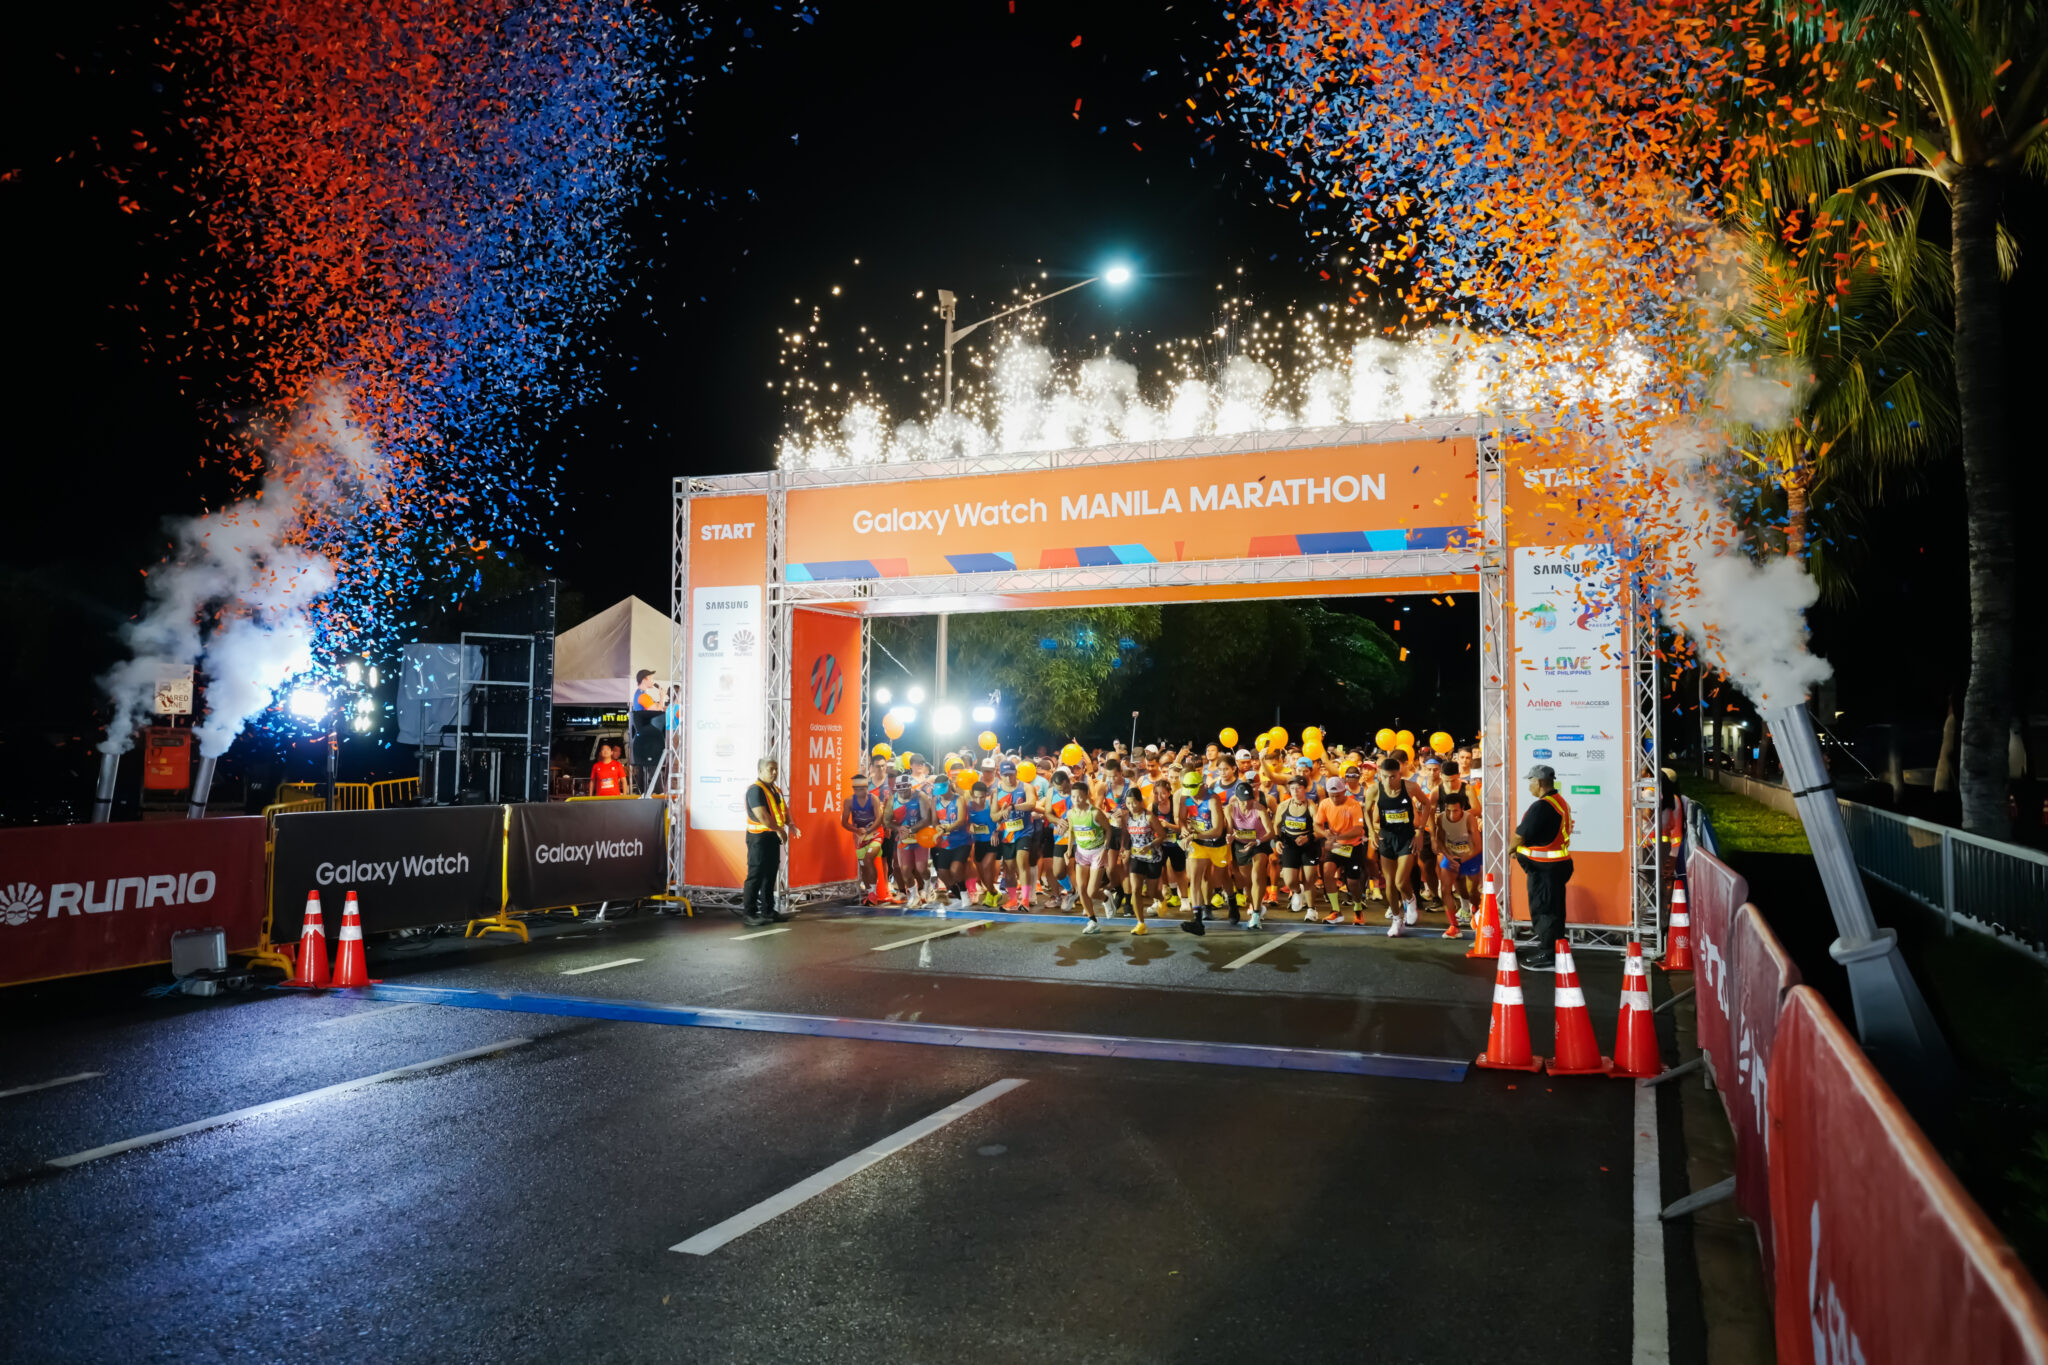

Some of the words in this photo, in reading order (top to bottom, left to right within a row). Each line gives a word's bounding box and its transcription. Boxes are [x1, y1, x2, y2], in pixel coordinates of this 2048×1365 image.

[1524, 465, 1600, 489] STAR
[853, 507, 950, 536] Galaxy
[954, 498, 1047, 527] Watch
[1061, 487, 1183, 521] MANILA
[1190, 473, 1386, 513] MARATHON
[701, 523, 755, 540] START
[1533, 563, 1599, 576] SAMSU
[705, 600, 749, 610] SAMSUNG
[1544, 656, 1592, 670] LOVE
[1527, 698, 1562, 708] Anlene
[835, 737, 843, 812] MARATHON
[535, 842, 594, 866] Galaxy
[595, 838, 643, 859] Watch
[315, 860, 399, 886] Galaxy
[402, 852, 469, 878] Watch
[47, 870, 216, 919] RUNRIO
